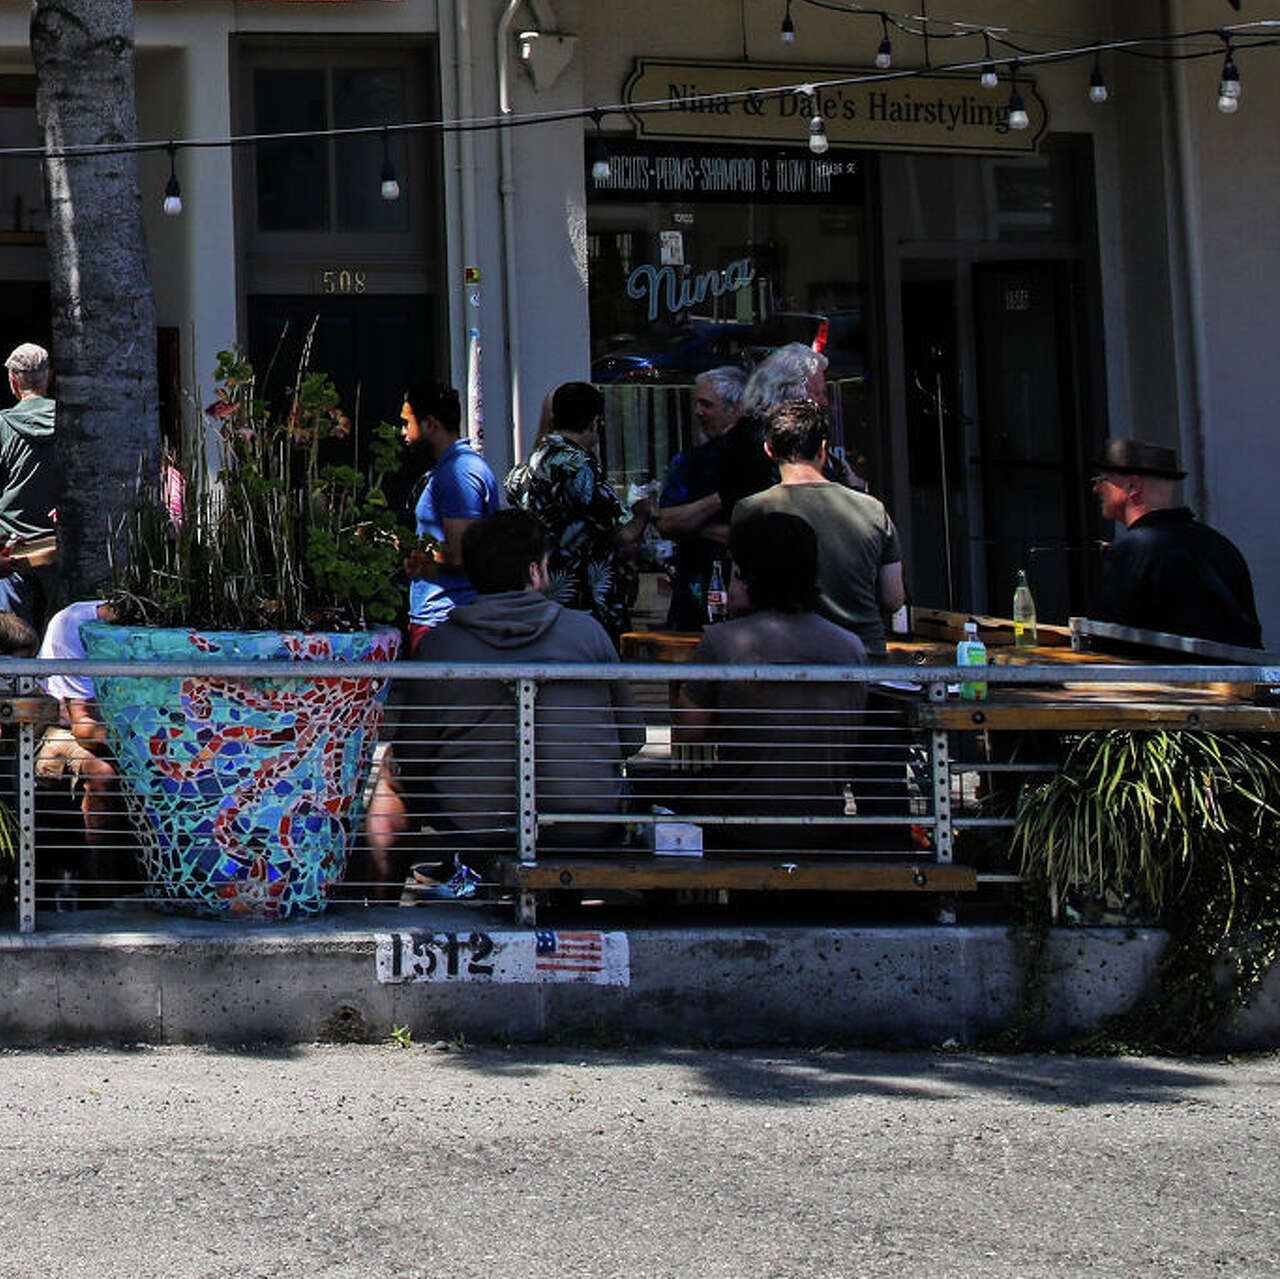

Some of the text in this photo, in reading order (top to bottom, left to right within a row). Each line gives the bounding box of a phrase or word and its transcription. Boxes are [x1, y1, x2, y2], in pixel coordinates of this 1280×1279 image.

[668, 83, 1010, 134] Nina & Dale's Hairstyling
[627, 257, 756, 322] Nina
[391, 931, 494, 976] 1512
